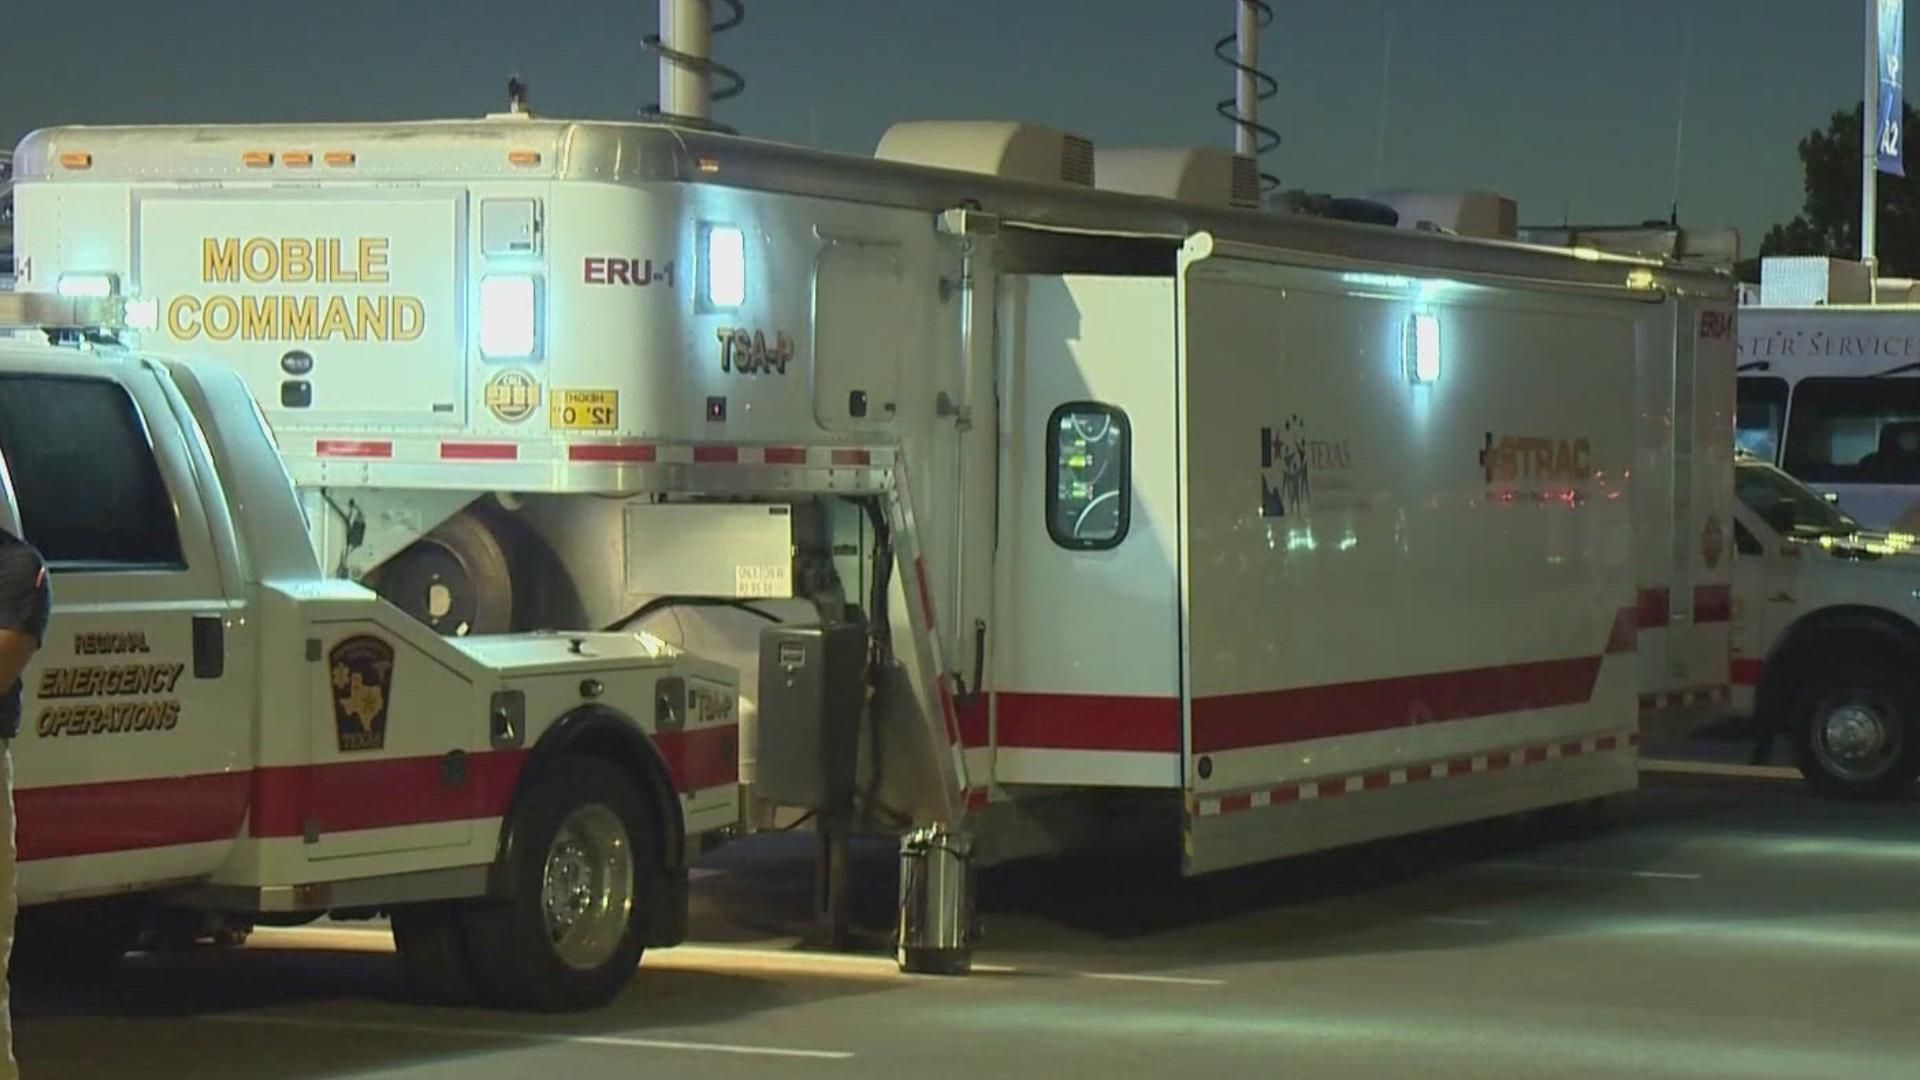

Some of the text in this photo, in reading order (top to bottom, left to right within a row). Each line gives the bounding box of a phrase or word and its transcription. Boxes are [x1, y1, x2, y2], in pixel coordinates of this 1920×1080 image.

[1880, 119, 1898, 156] A2
[203, 237, 390, 283] MOBILE
[584, 257, 675, 287] ERU-1
[167, 294, 426, 342] COMMAND
[717, 327, 796, 374] TSA-P
[37, 663, 186, 699] EMERGENCY
[35, 700, 181, 738] OPERATIONS
